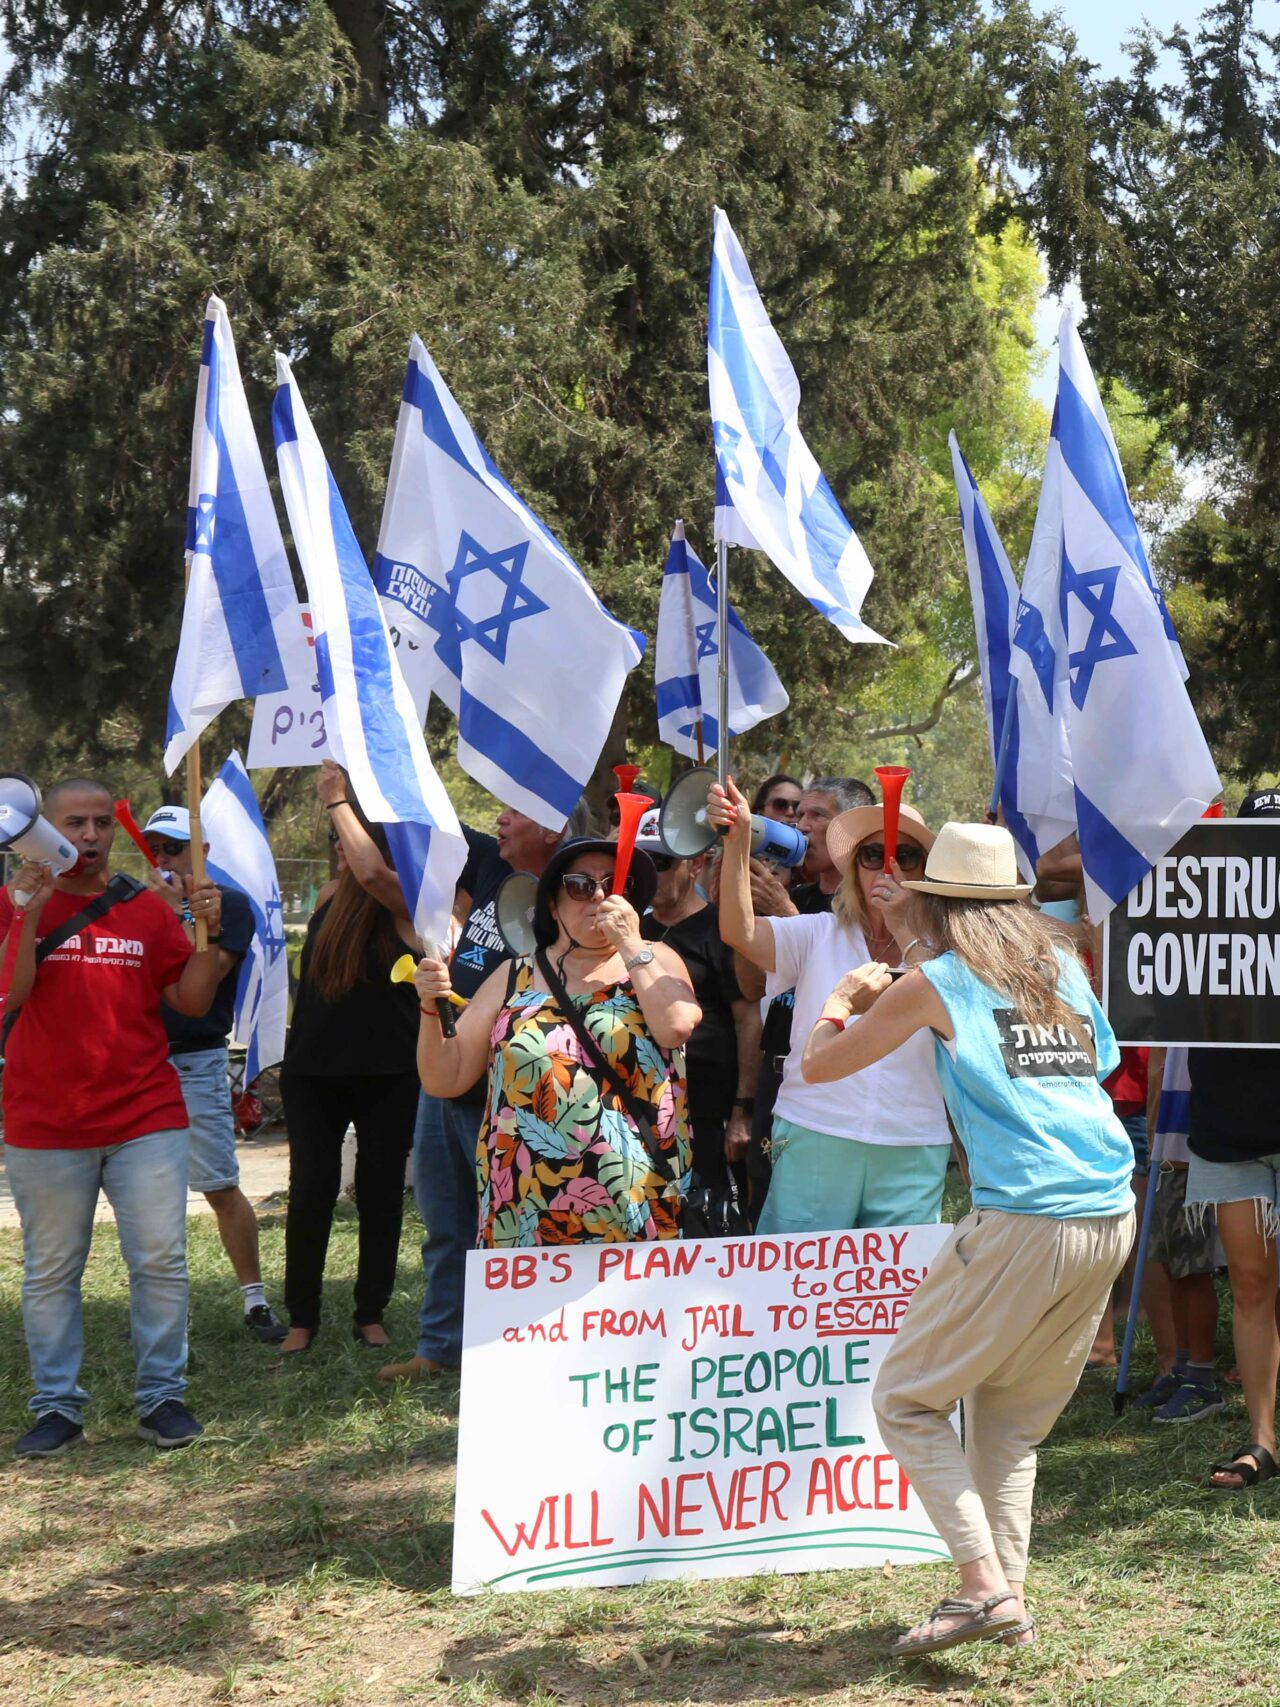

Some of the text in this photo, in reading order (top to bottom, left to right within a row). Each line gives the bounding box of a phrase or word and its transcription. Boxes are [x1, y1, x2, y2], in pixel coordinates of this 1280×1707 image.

[95, 937, 144, 956] מאבק
[485, 1252, 573, 1290] BB'S
[792, 1266, 928, 1298] to CRAS
[502, 1300, 910, 1352] and FROM JAIL TO ESCAP
[568, 1340, 871, 1408] THE PEOPOLE
[603, 1397, 865, 1462] OF ISRAEL
[481, 1454, 911, 1556] WILL NEVER ACCE
